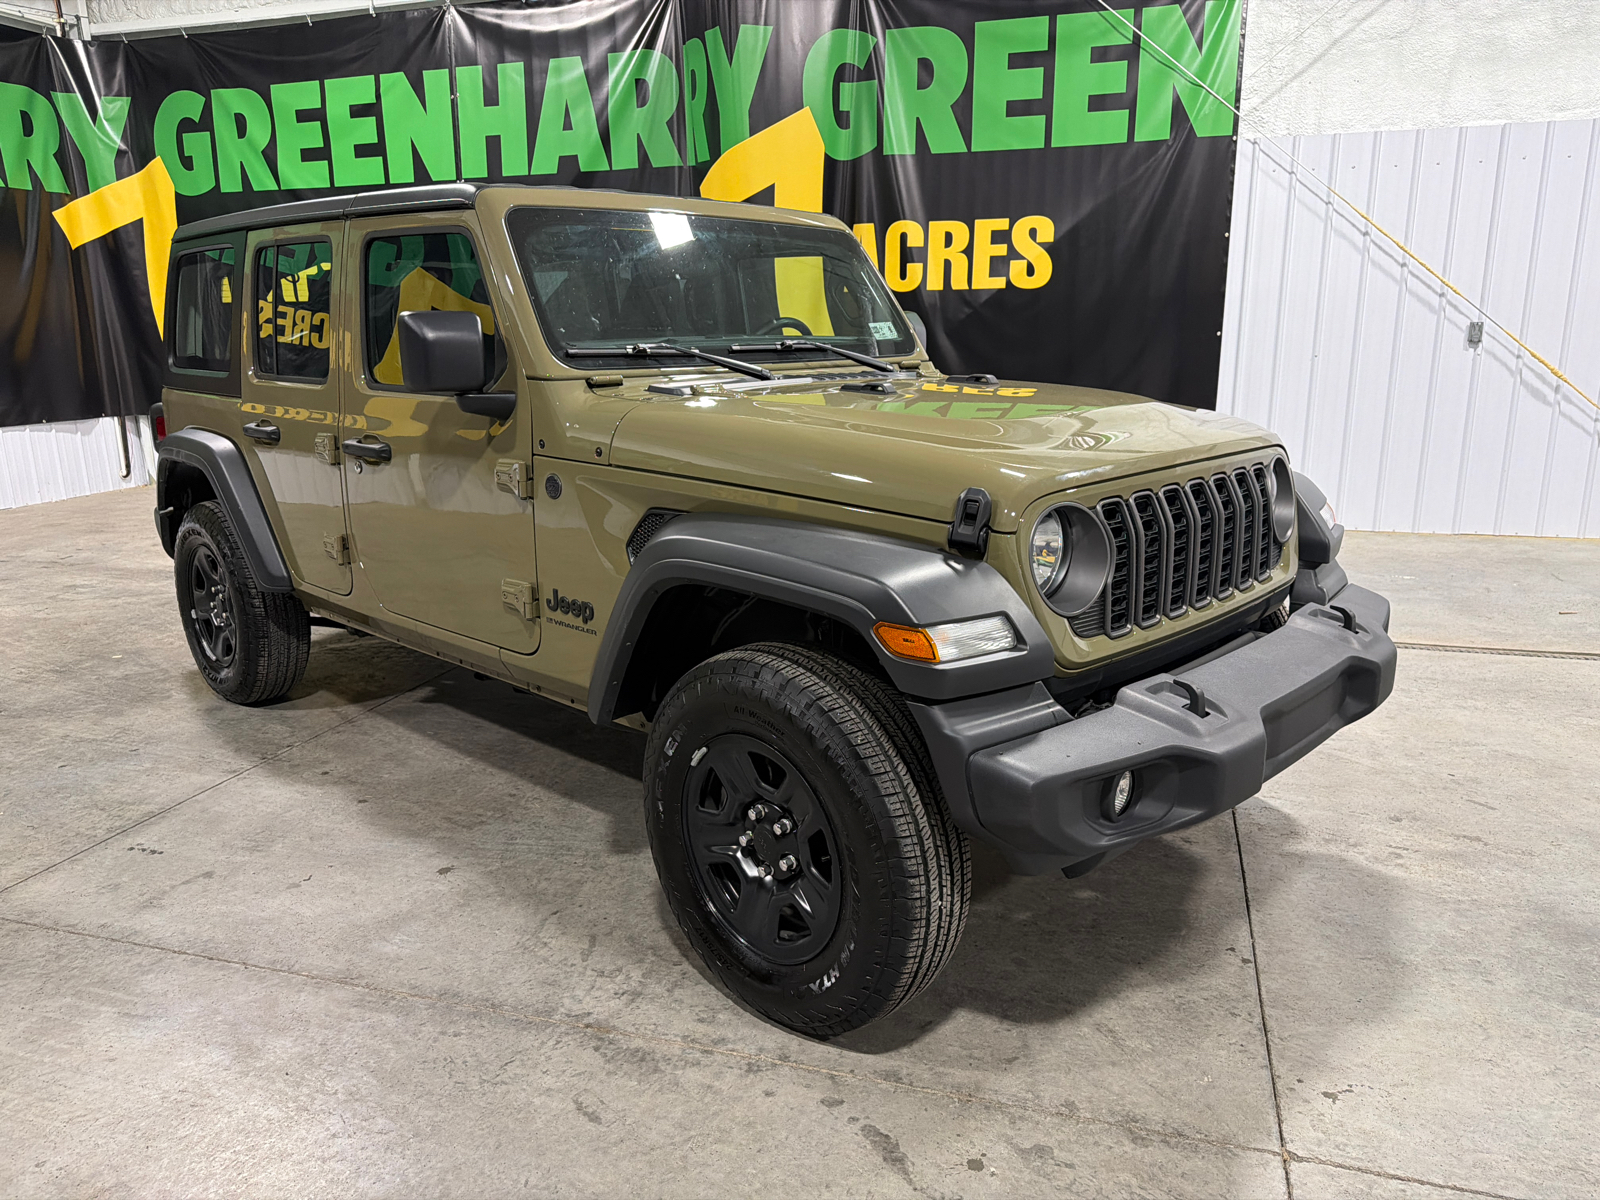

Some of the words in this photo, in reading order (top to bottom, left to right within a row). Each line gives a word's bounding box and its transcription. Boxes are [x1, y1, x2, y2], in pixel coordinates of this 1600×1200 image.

[455, 24, 774, 178] HARRY
[802, 0, 1243, 161] GREEN
[0, 81, 131, 194] RY
[153, 69, 457, 197] GREEN
[545, 587, 595, 625] Jeep
[553, 618, 598, 637] WRANGLER
